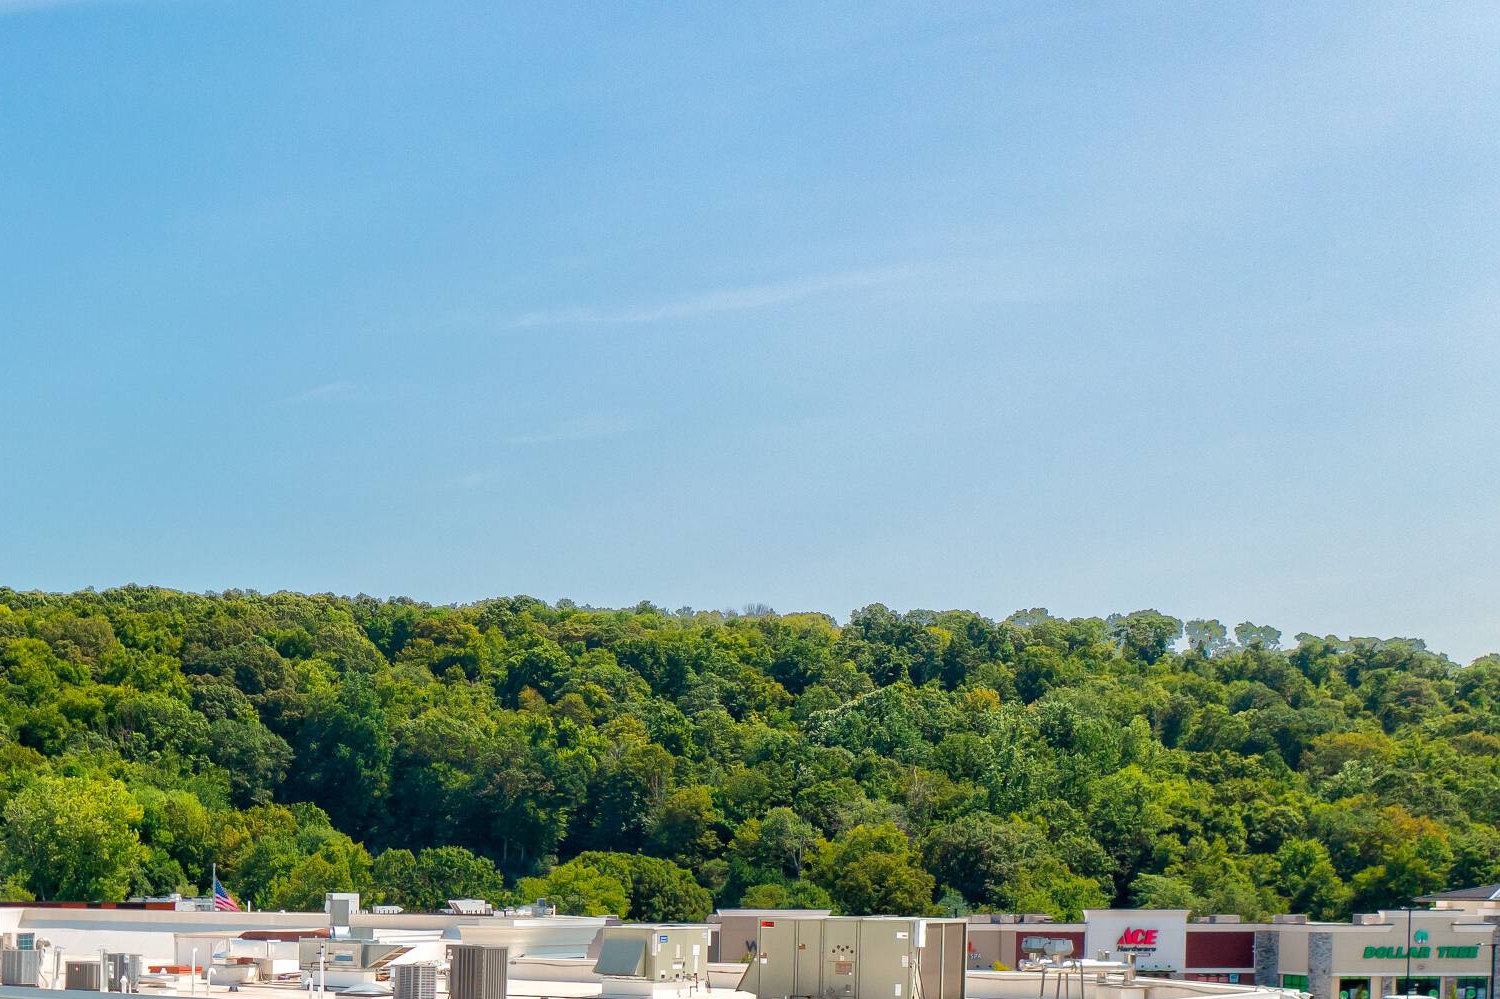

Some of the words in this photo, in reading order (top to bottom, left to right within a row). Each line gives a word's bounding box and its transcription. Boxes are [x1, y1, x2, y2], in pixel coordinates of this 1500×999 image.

[1116, 927, 1159, 945] ACE
[1363, 946, 1431, 959] DOLLAR
[1436, 946, 1479, 959] TREE
